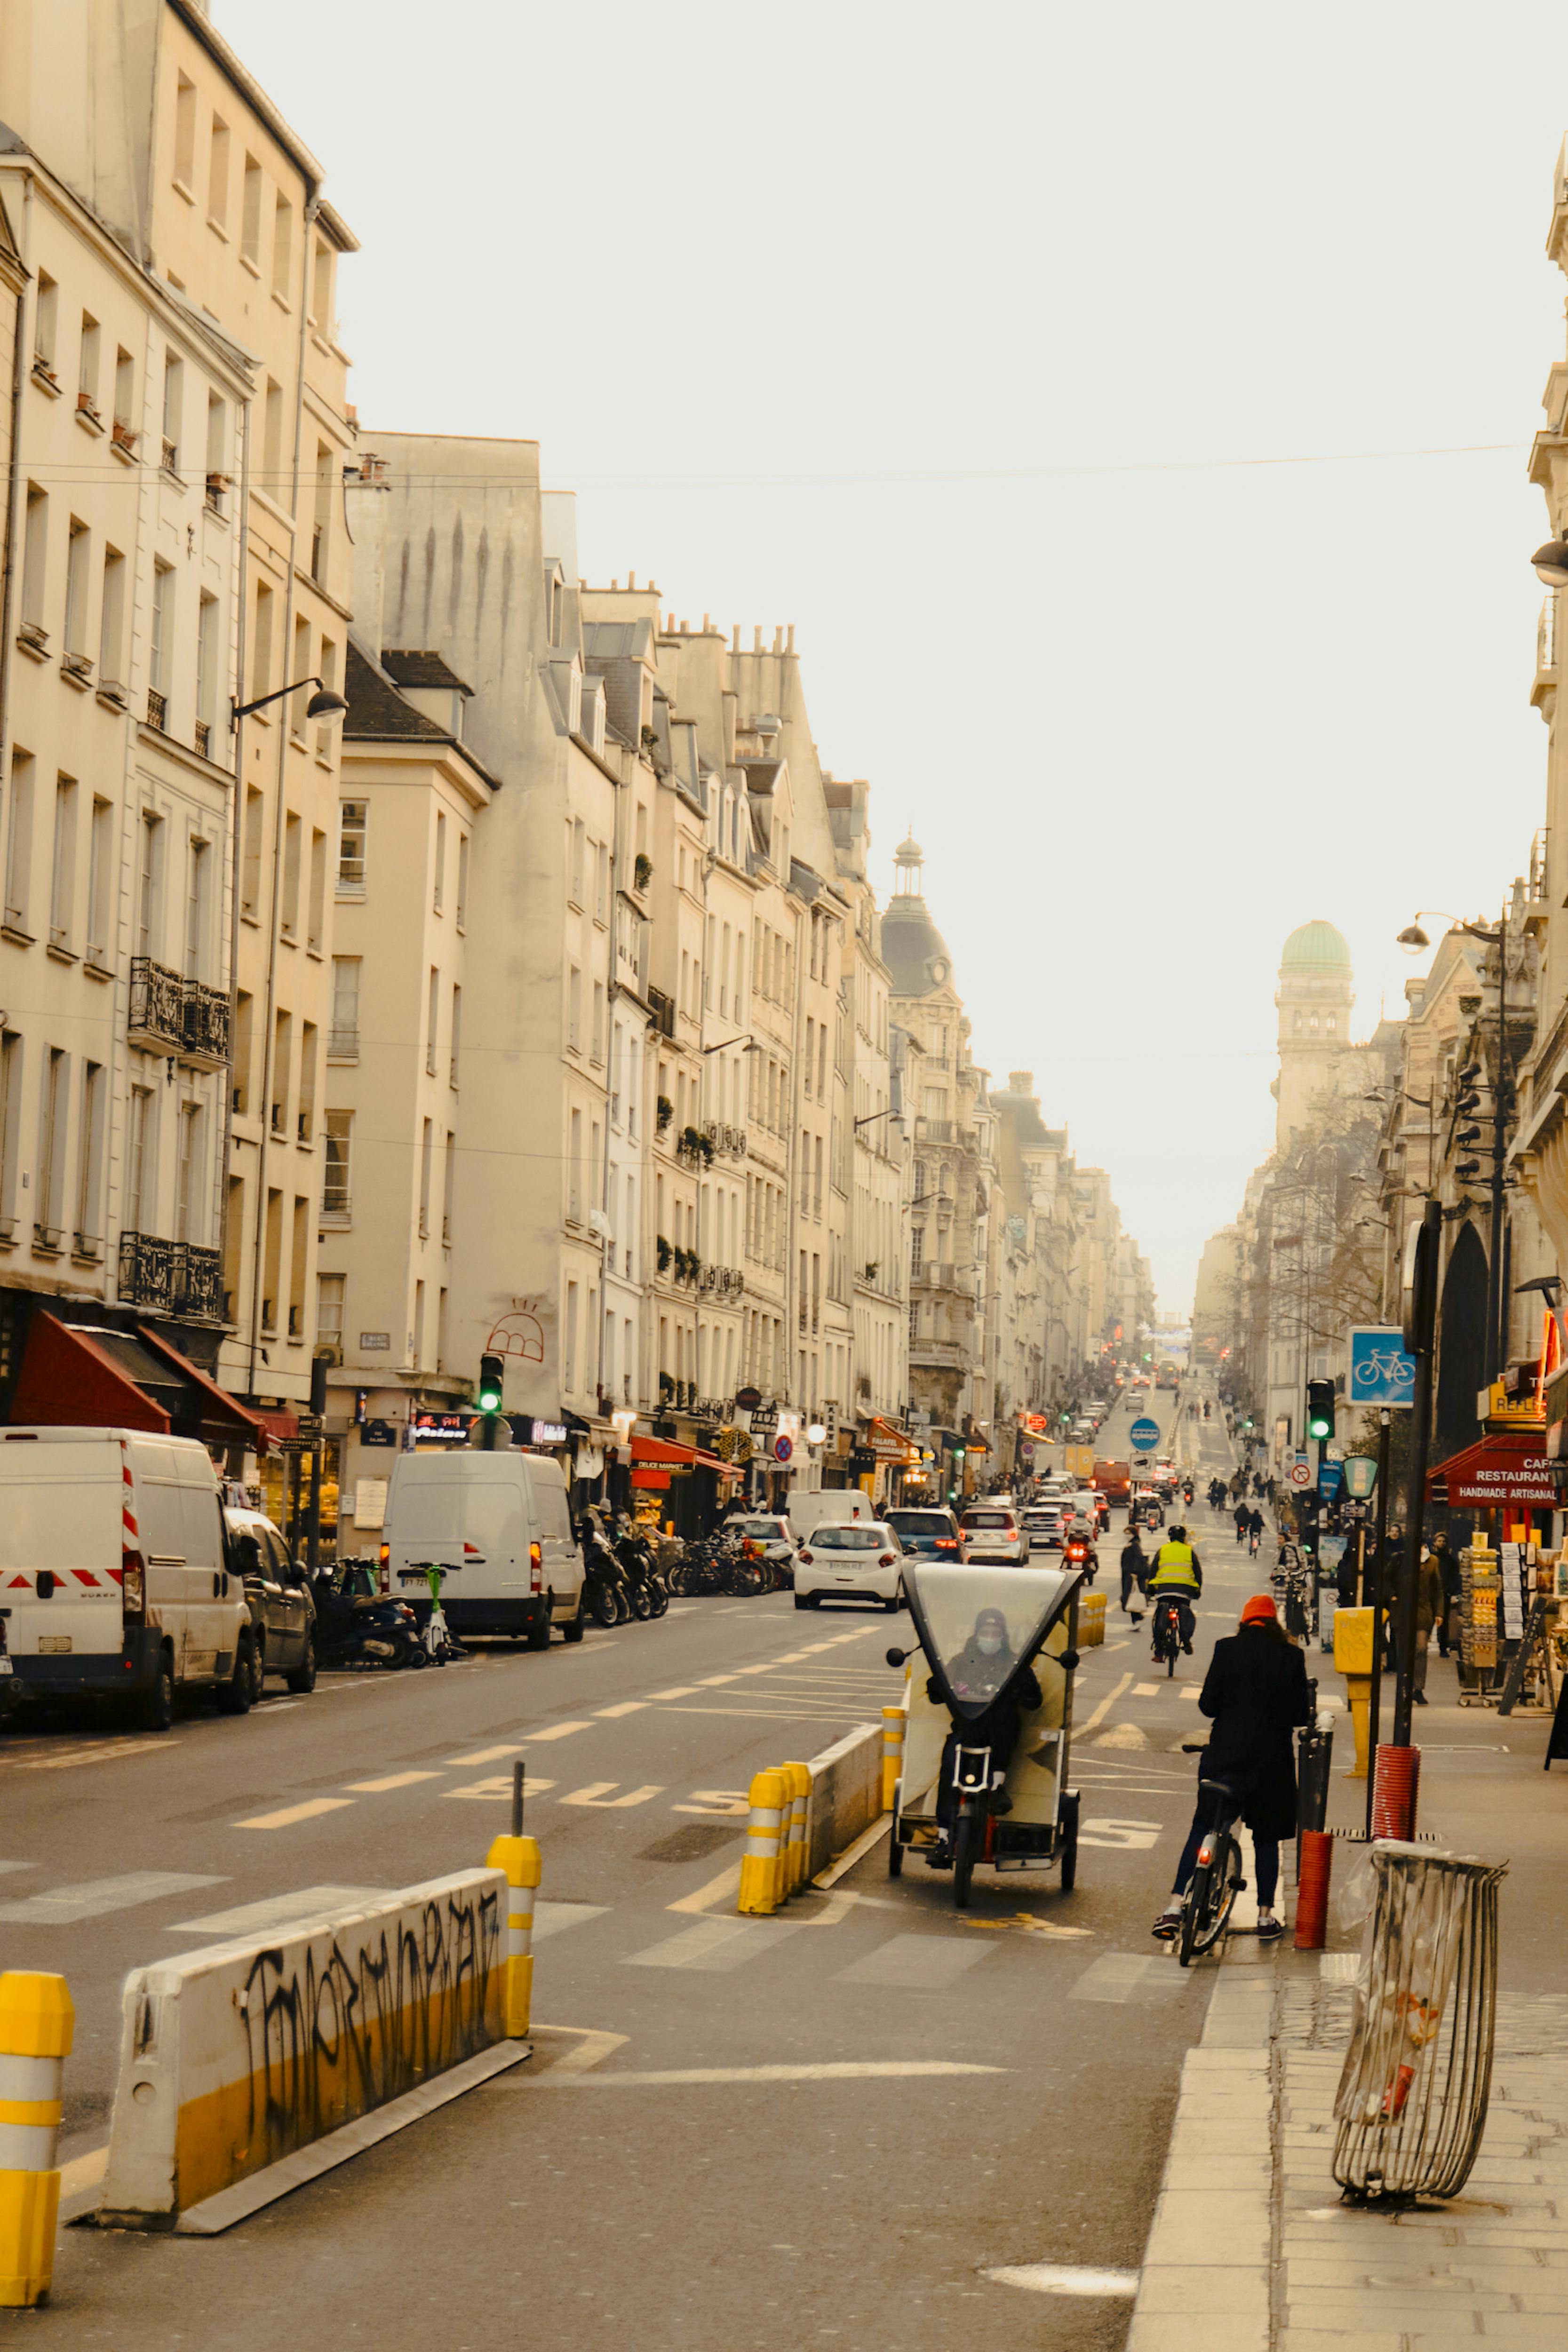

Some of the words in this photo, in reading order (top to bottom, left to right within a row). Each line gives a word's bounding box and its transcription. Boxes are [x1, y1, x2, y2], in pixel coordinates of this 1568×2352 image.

[1524, 1458, 1552, 1469] CAF
[1460, 1486, 1507, 1498] HANDMADE
[1510, 1488, 1558, 1500] ARTISANAL
[438, 1776, 750, 1816] BUS
